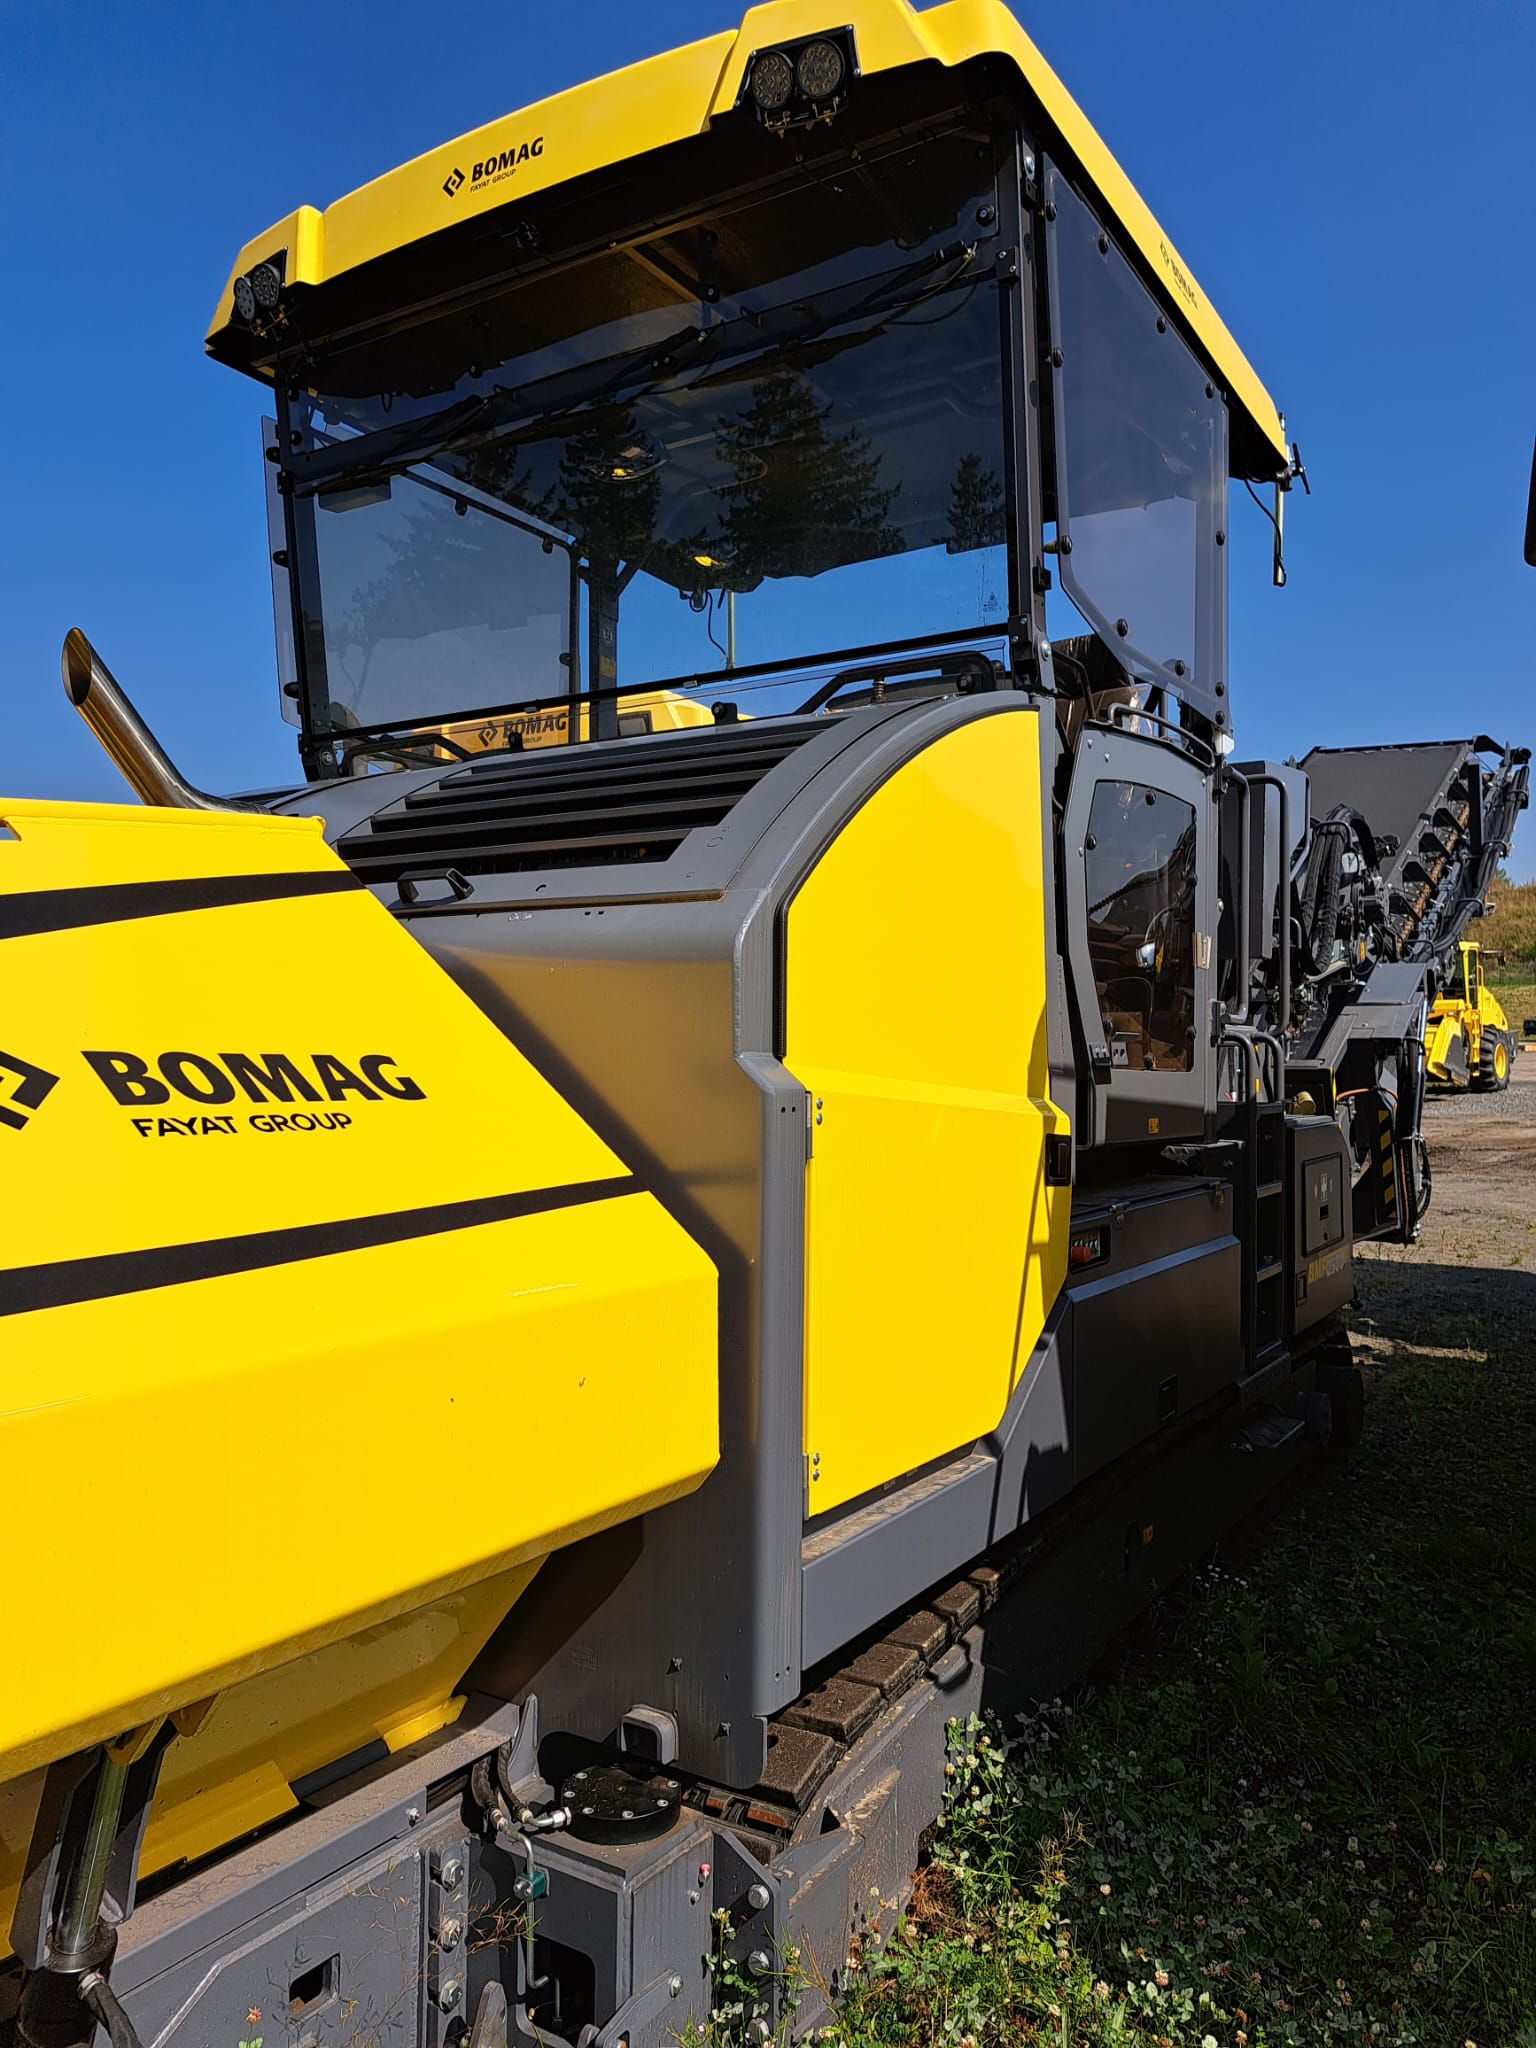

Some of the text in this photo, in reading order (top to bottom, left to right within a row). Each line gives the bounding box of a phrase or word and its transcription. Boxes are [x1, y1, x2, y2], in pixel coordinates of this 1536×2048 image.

[471, 136, 544, 182] BOMAG
[470, 168, 517, 193] FAYAT GROUP
[503, 713, 567, 738] BOMAG
[81, 1050, 427, 1106] BOMAG
[131, 1113, 353, 1138] FAYAT GROUP
